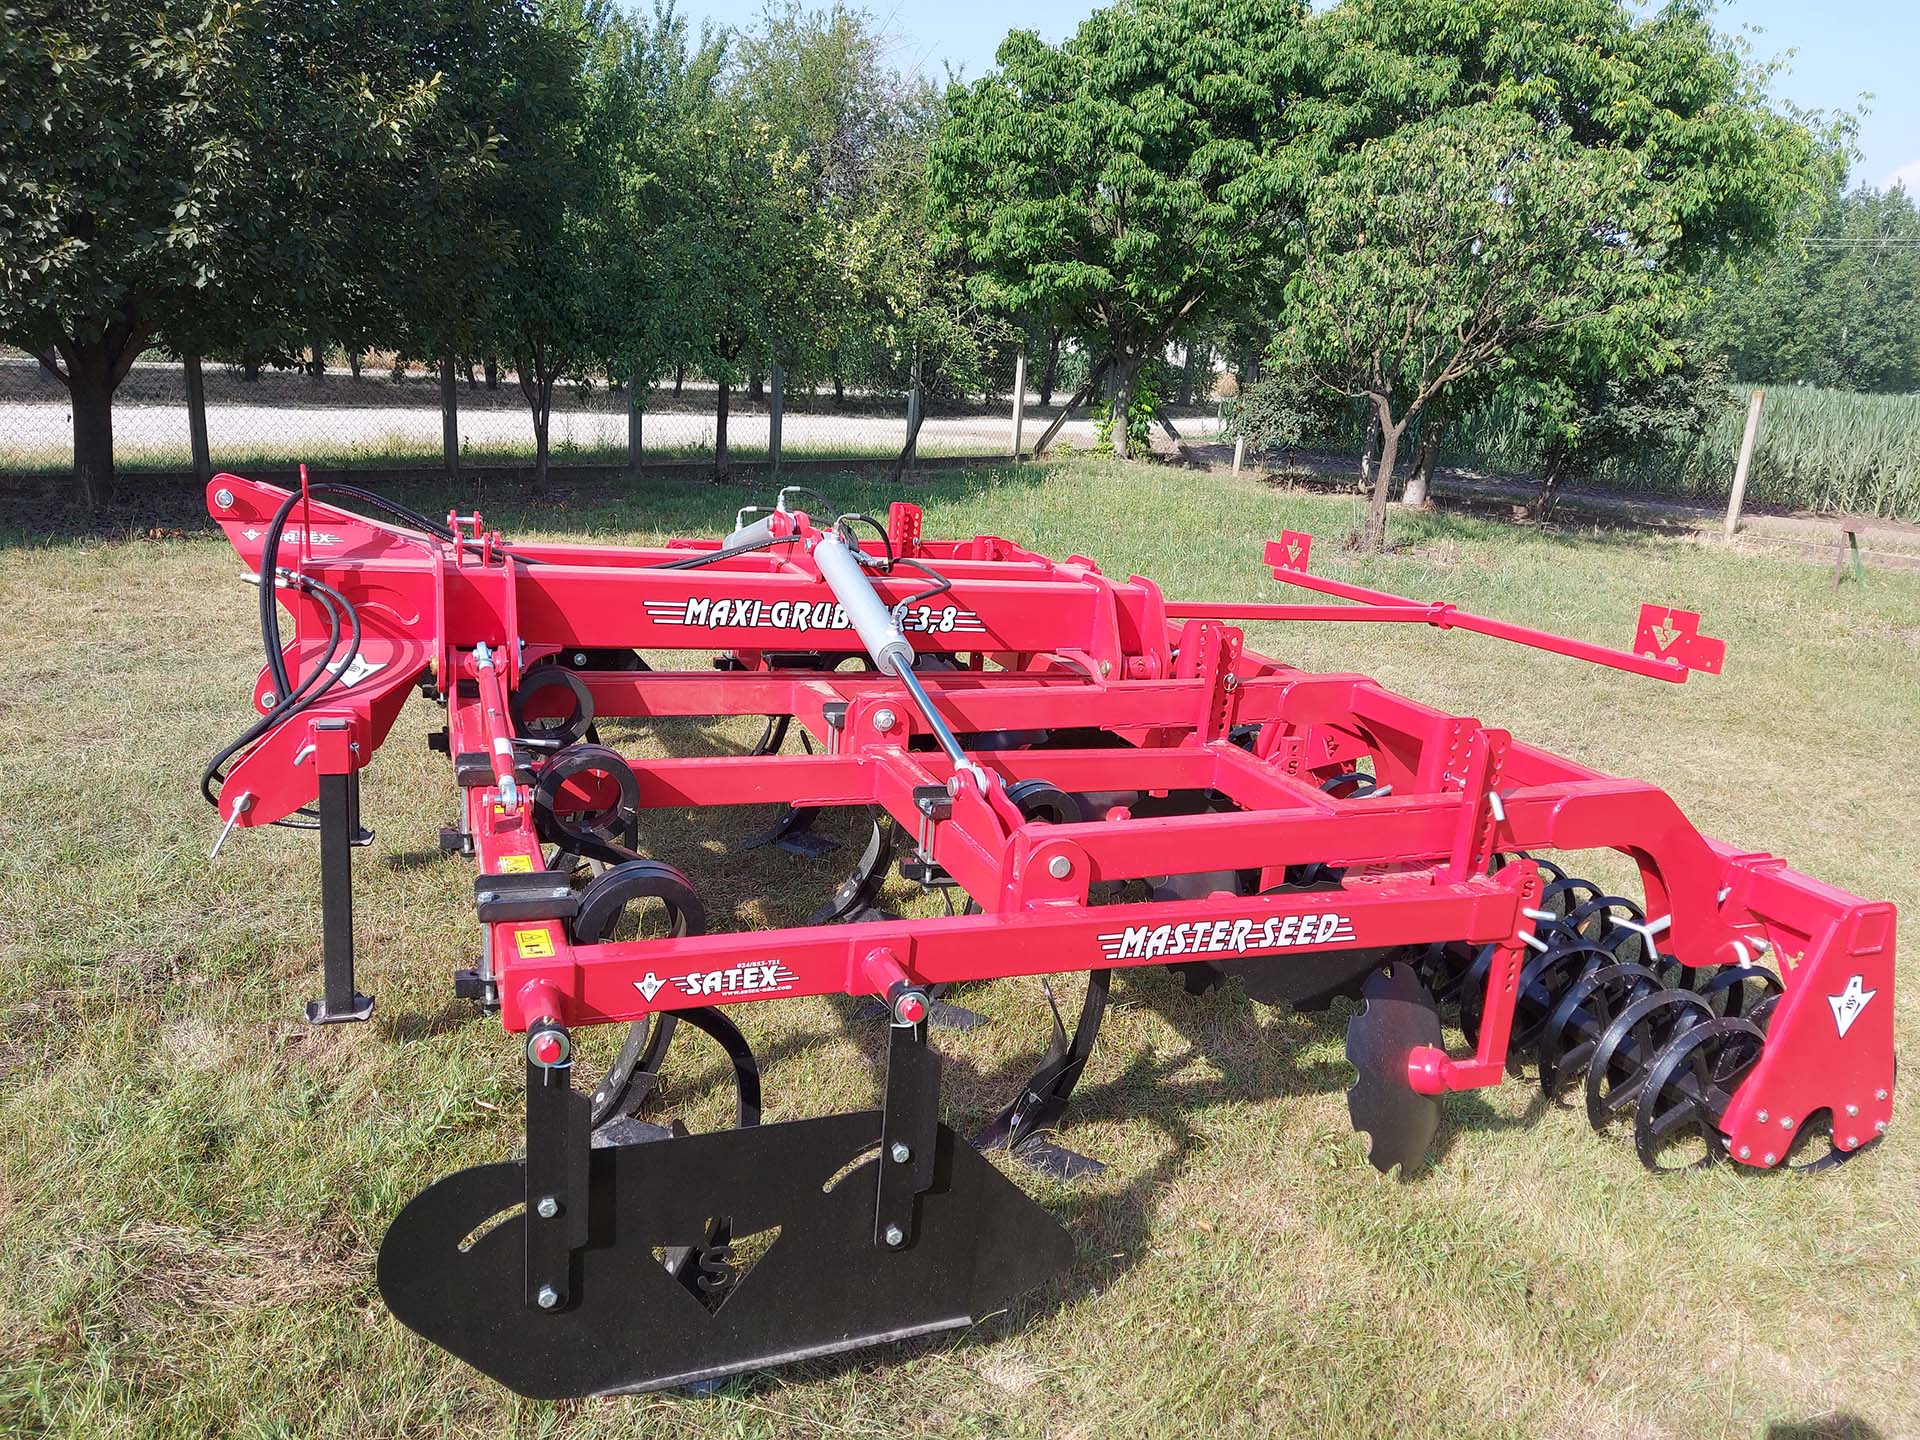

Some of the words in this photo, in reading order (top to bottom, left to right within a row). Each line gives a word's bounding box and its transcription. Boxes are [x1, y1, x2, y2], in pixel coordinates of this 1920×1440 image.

[684, 598, 760, 629] MAXI
[770, 600, 909, 633] GRUBR
[914, 605, 957, 634] 3,8
[1117, 919, 1252, 960] MASTER
[1258, 913, 1340, 948] SEED
[685, 965, 779, 996] SATEX
